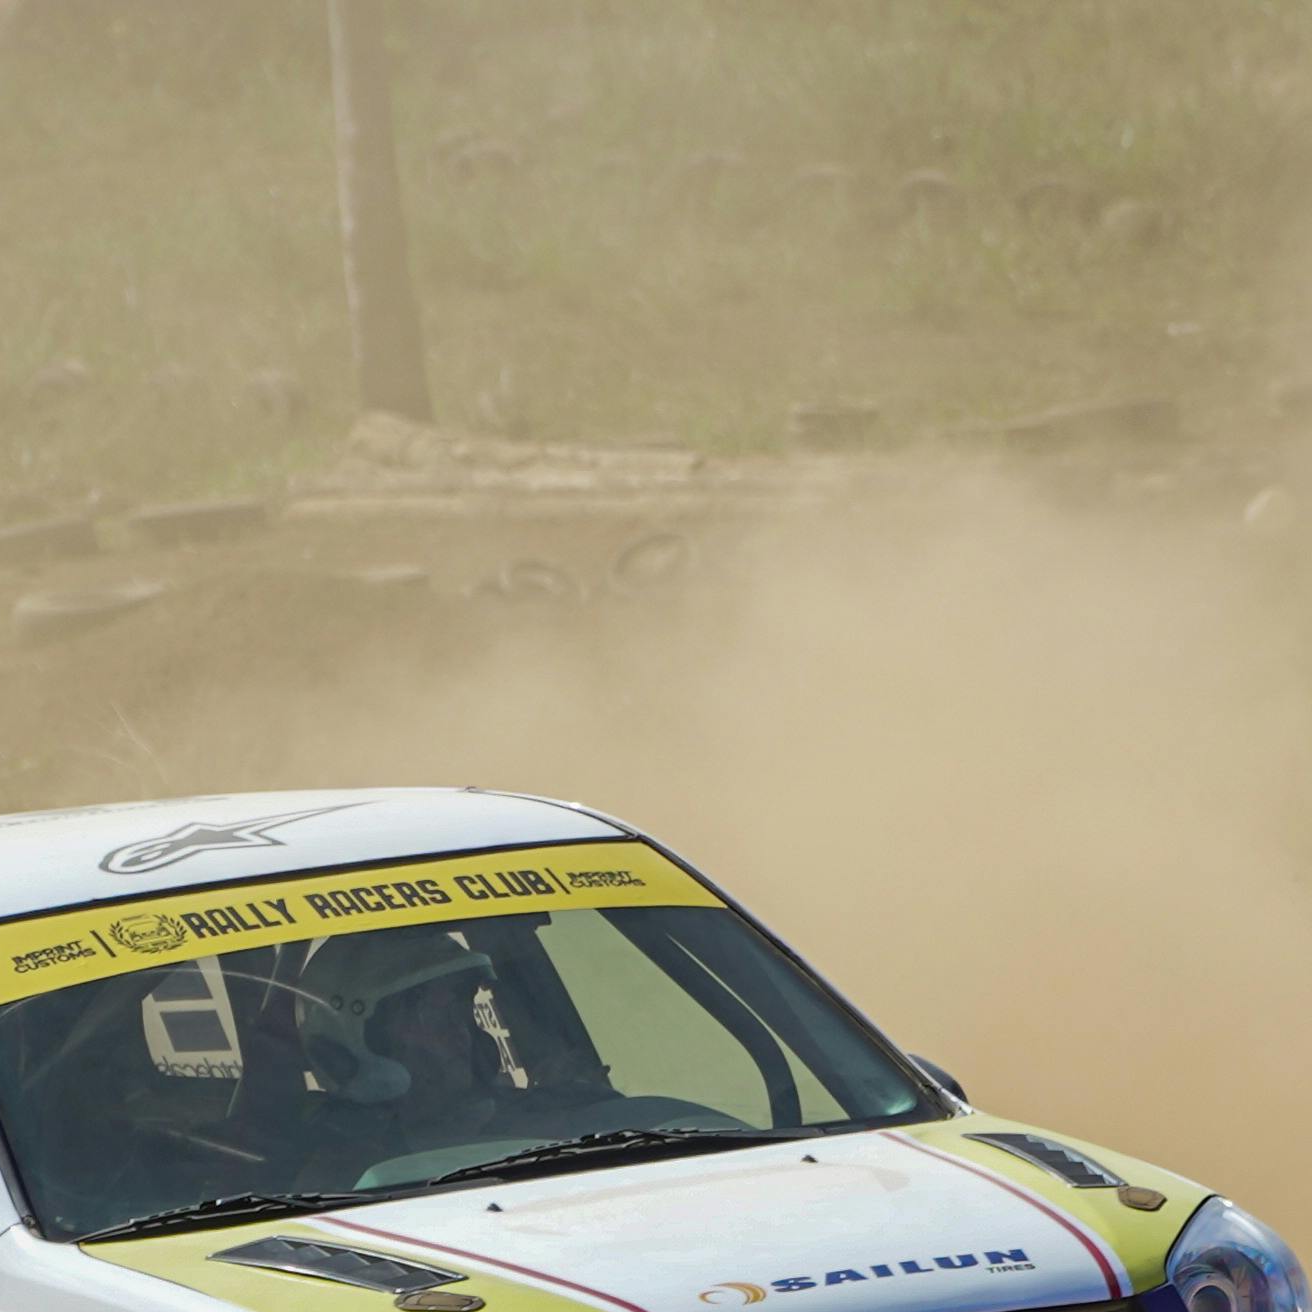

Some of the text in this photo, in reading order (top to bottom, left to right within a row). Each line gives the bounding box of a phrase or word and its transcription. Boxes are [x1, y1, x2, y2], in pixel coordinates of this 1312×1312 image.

[181, 869, 556, 940] RALLY RACERS CLUB
[12, 939, 82, 964] IMPRINT
[14, 948, 96, 974] CUSTOMS
[770, 1248, 1031, 1293] SAILUN
[985, 1262, 1036, 1275] TIRES
